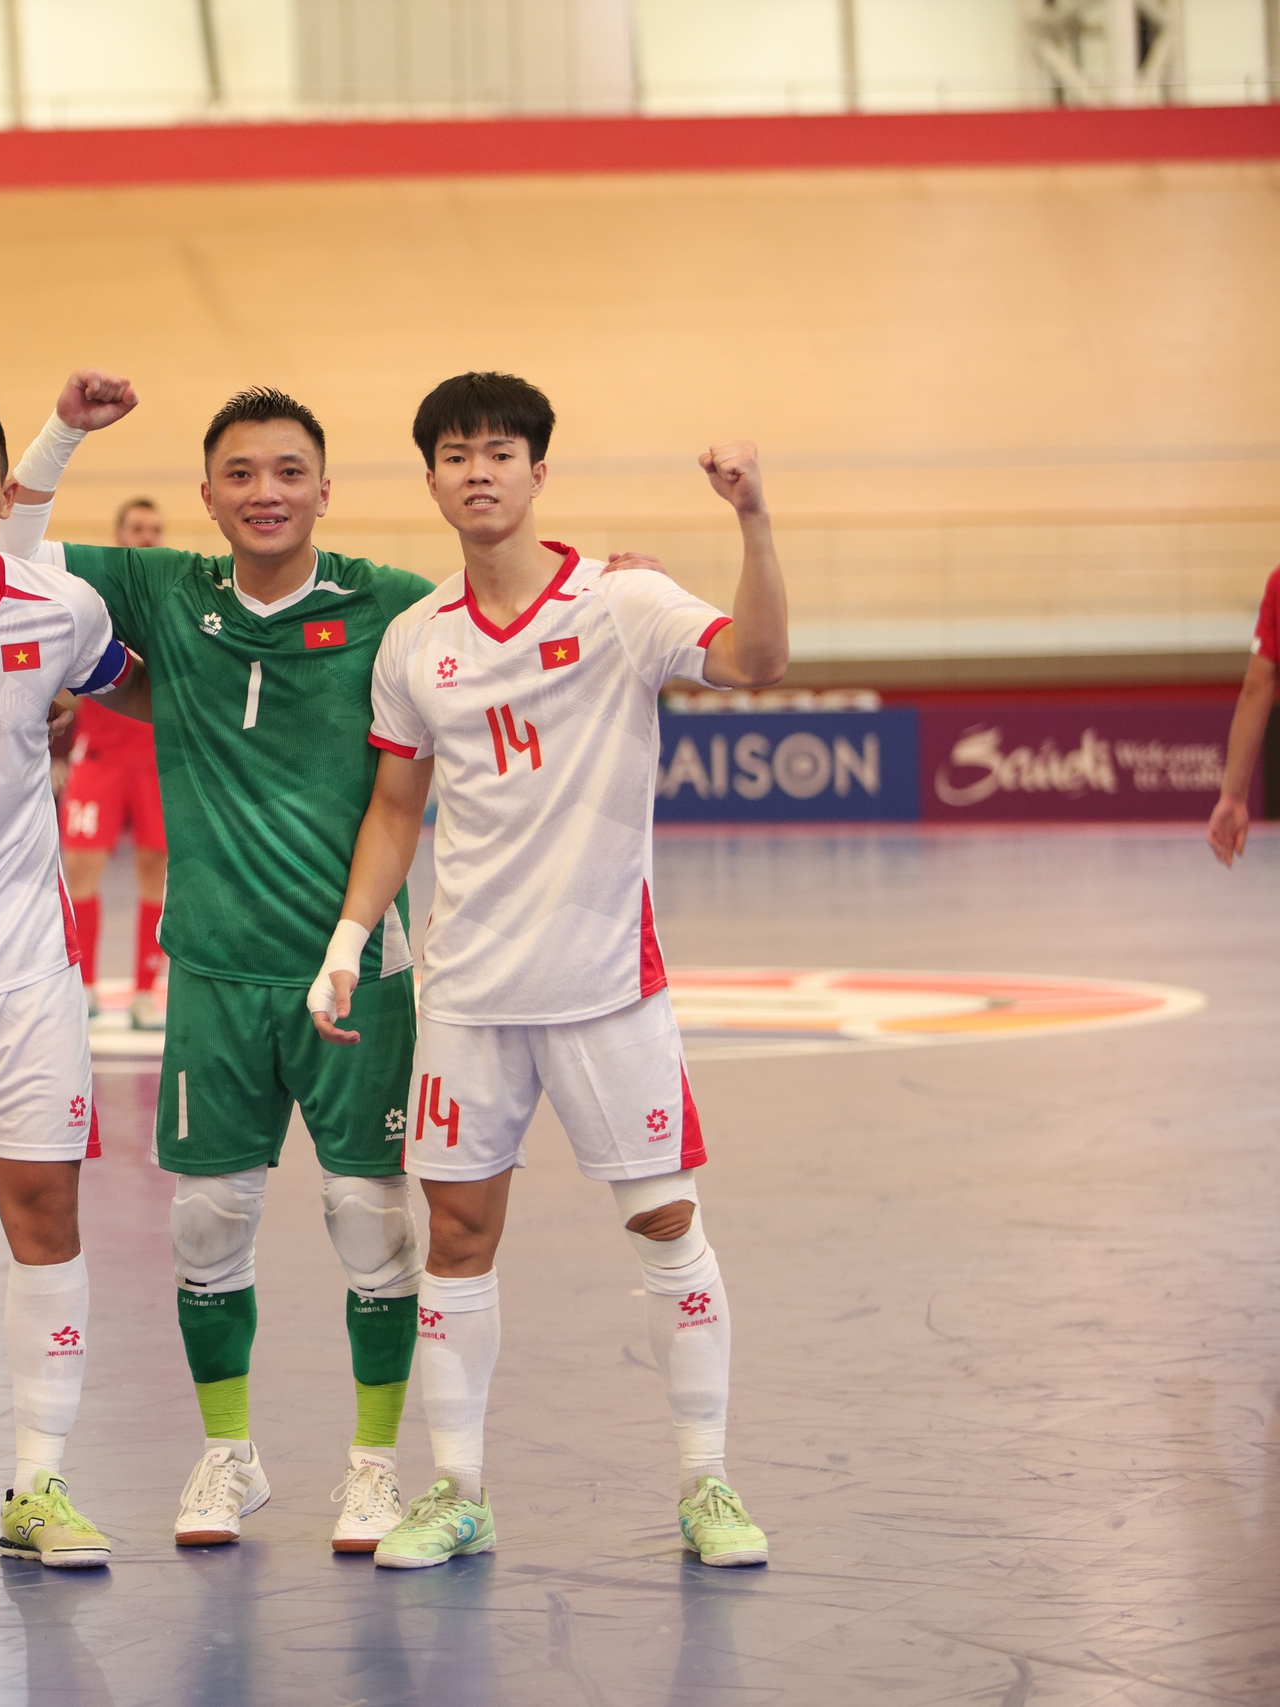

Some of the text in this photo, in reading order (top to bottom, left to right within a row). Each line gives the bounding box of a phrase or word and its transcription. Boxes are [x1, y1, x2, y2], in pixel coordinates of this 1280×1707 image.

[242, 660, 263, 730] 1
[485, 703, 543, 777] 14
[415, 1073, 461, 1148] 14
